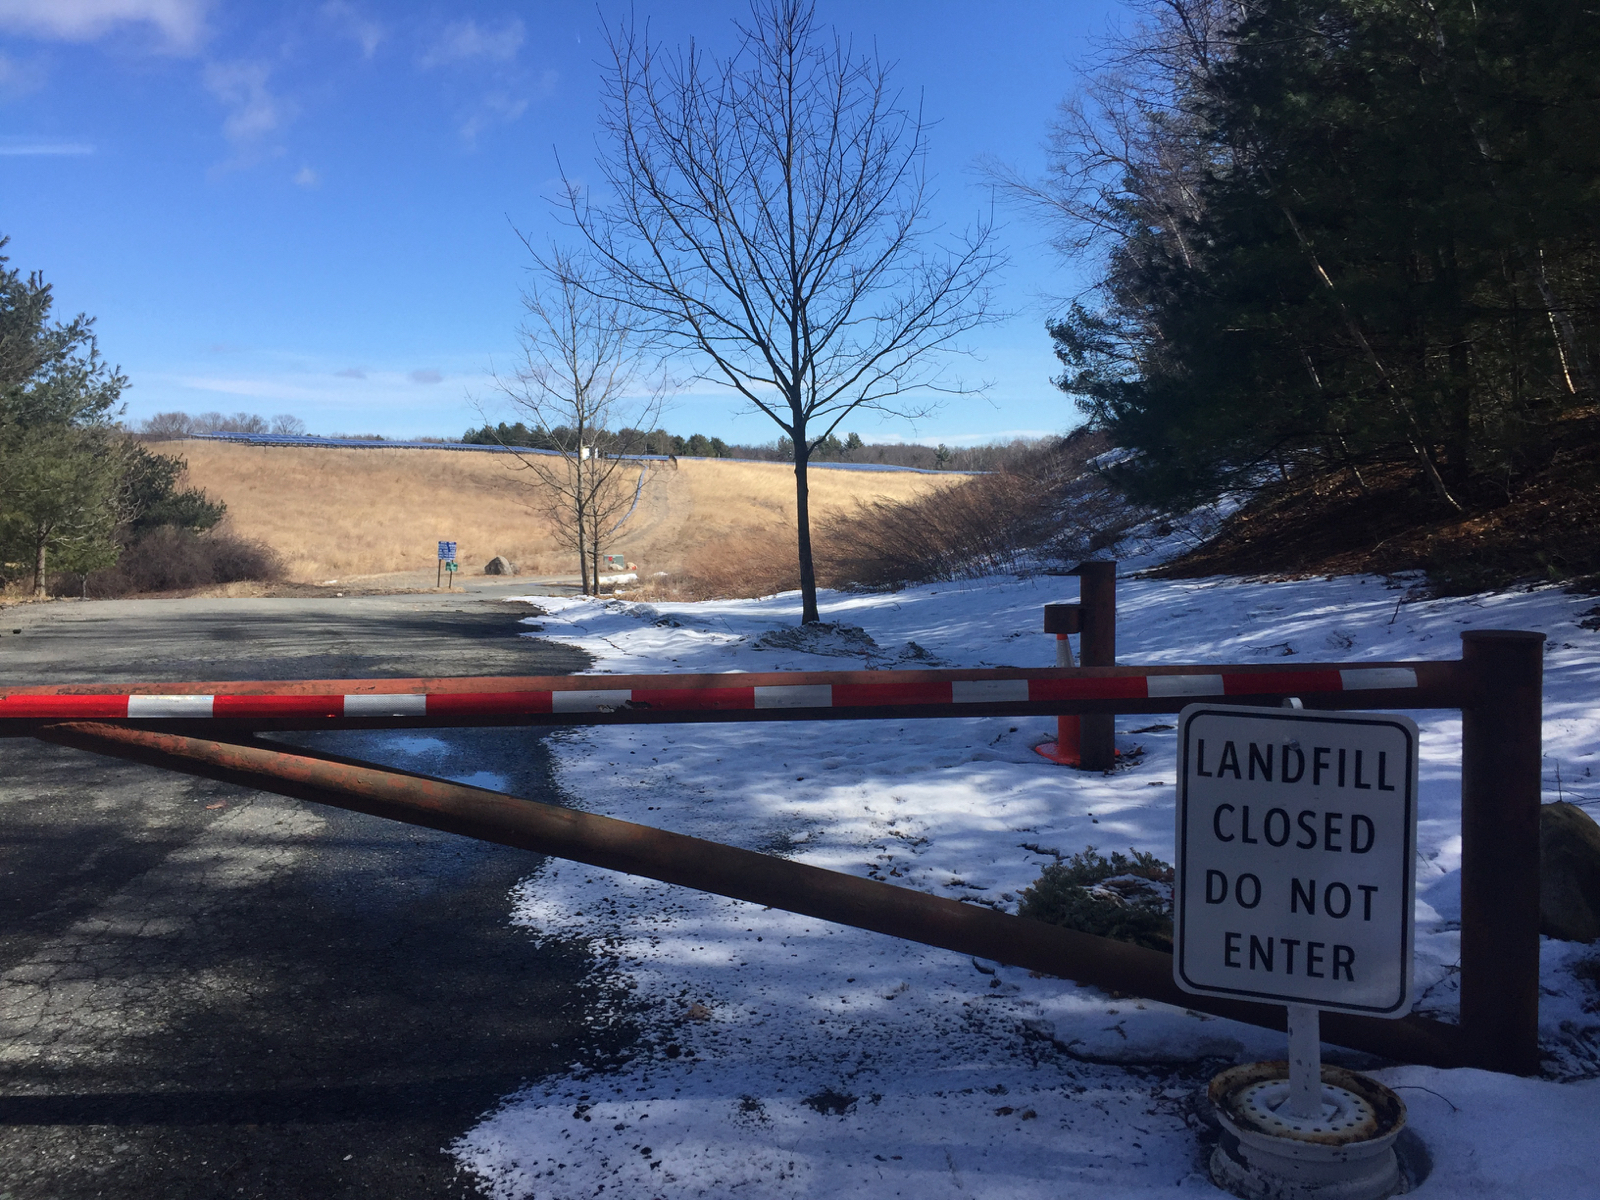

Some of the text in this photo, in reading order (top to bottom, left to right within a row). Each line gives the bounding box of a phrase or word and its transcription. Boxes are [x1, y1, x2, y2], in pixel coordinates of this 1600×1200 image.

[1197, 738, 1395, 791] LANDFILL
[1213, 803, 1375, 854] CLOSED
[1205, 869, 1379, 921] DO NOT
[1224, 931, 1356, 982] ENTER
